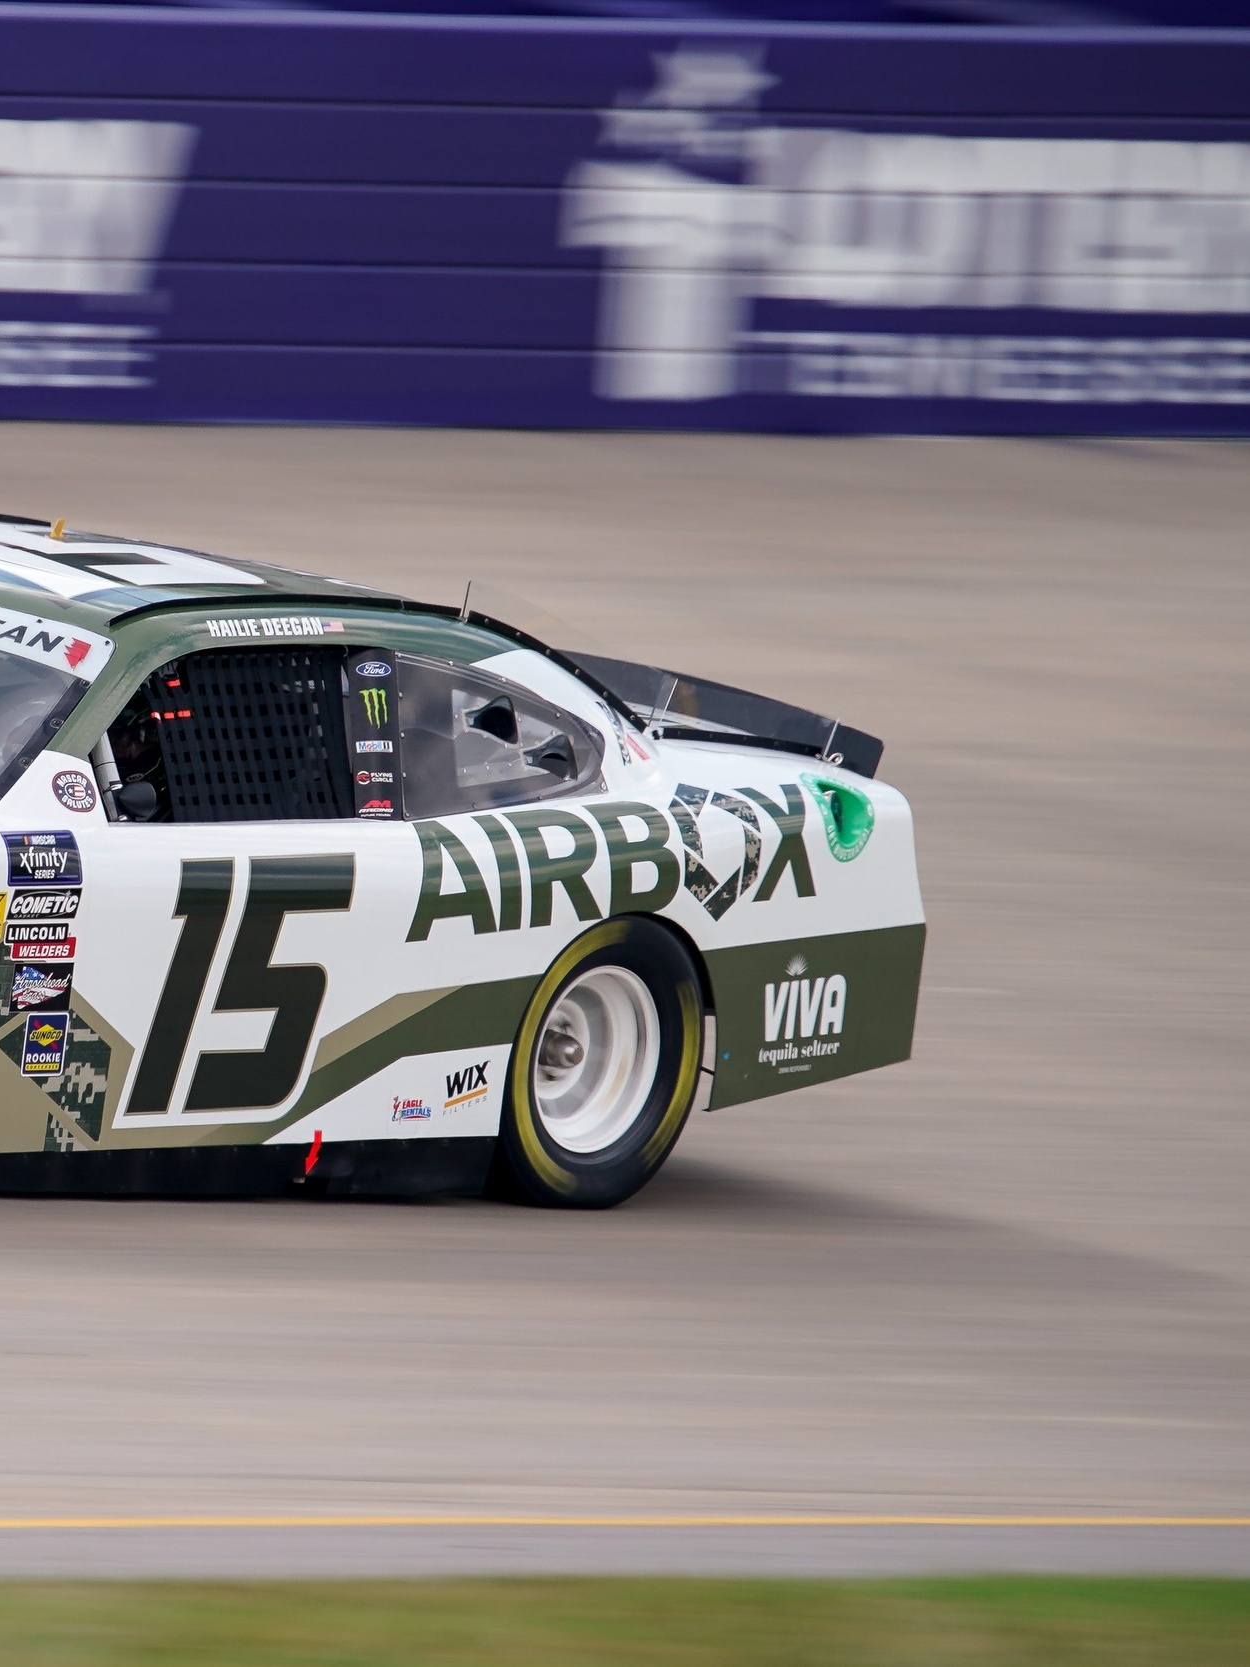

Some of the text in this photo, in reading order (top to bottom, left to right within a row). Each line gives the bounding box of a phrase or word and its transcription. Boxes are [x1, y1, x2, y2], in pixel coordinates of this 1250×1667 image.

[206, 616, 325, 638] HAILIE DEEGAN
[362, 664, 386, 675] Ford
[358, 740, 382, 751] Mobil
[55, 773, 88, 788] NASCAR
[61, 794, 94, 809] SALUTES
[31, 834, 56, 846] NASCAR
[19, 846, 69, 874] xfinity
[405, 783, 817, 943] AIRBOX
[34, 869, 56, 879] SERIES
[10, 895, 79, 914] COMETIC
[7, 925, 67, 941] LINCOLN
[18, 944, 70, 957] WELDERS
[11, 971, 71, 990] Arrowhead
[122, 851, 357, 1117] 15
[764, 973, 847, 1042] VIVA
[30, 1030, 62, 1041] SUNOCO
[25, 1052, 62, 1063] ROOKIE
[758, 1039, 841, 1067] tequila seltzer
[445, 1060, 490, 1099] WIX
[401, 1106, 432, 1118] RENTALS
[402, 1099, 423, 1110] EAGLE
[442, 1094, 488, 1117] FILTERS
